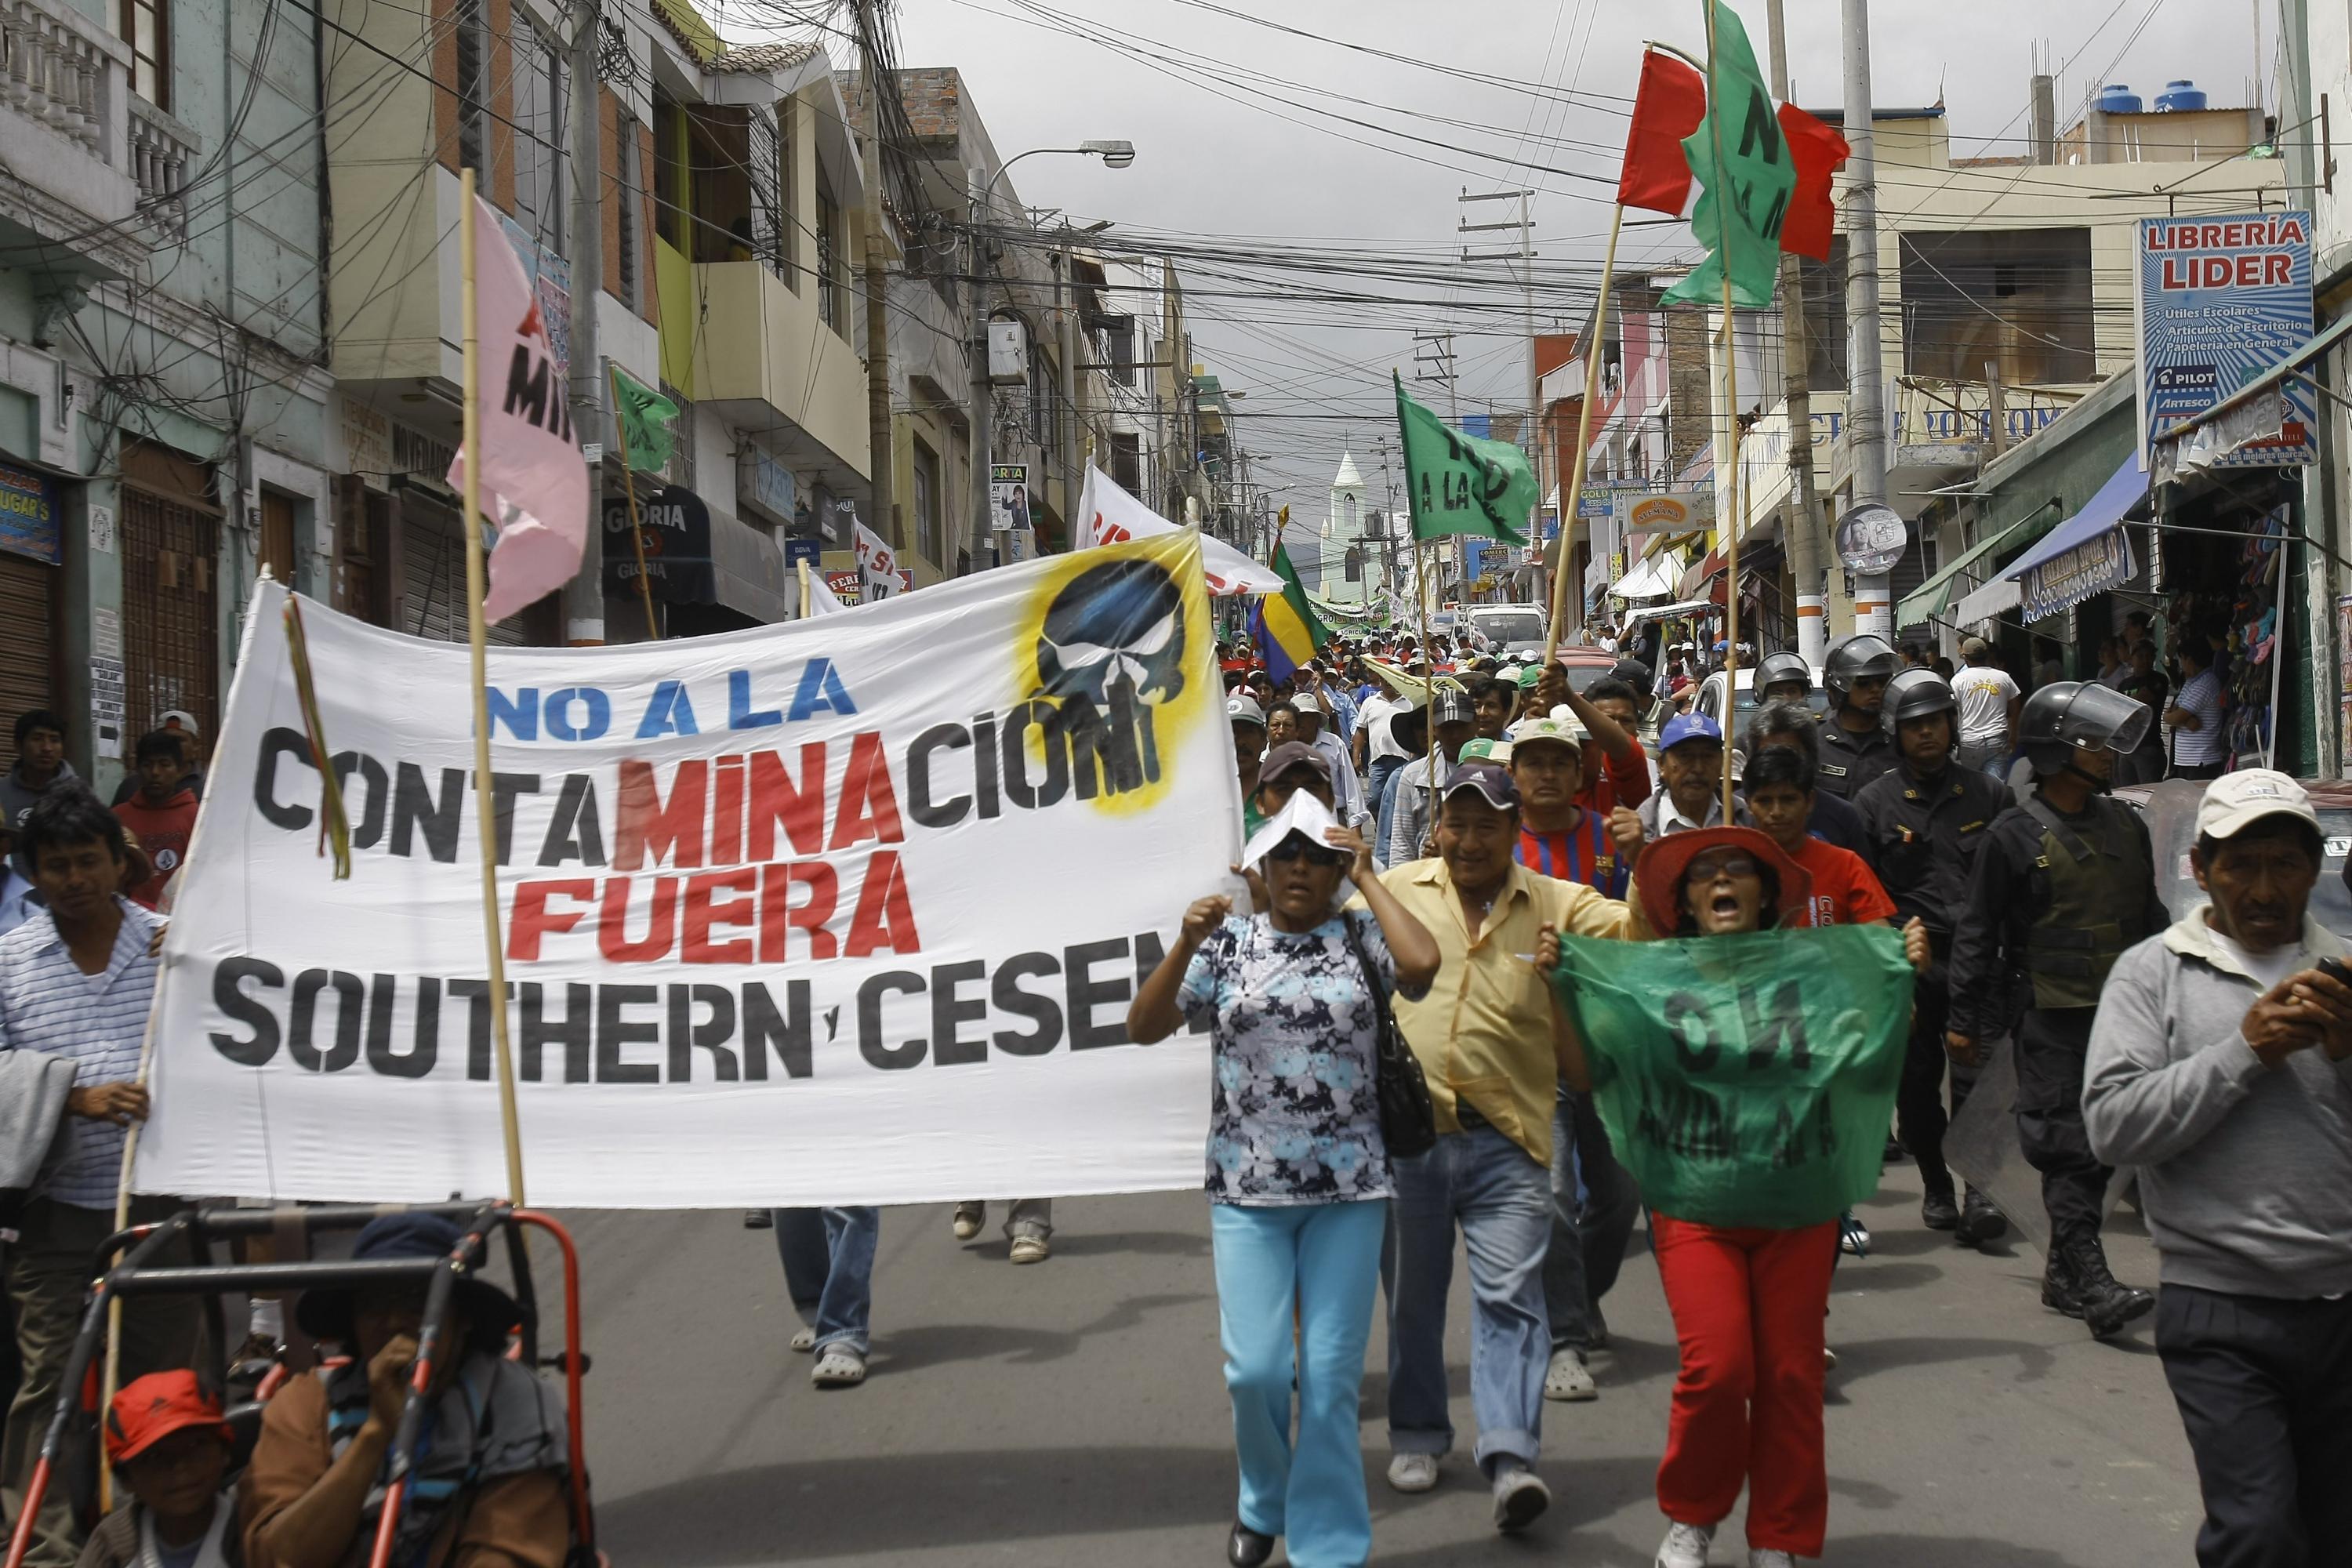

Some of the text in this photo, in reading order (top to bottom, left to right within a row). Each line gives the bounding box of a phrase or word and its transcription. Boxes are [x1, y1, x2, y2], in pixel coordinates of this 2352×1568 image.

[2147, 216, 2304, 251] LIBRERÍA
[2163, 254, 2293, 289] LIDER
[2203, 306, 2260, 318] Escolares
[2225, 323, 2242, 332] de
[2243, 321, 2303, 332] Escritorio
[2226, 341, 2241, 350] en
[2245, 336, 2294, 349] General
[2176, 372, 2215, 384] PILOT
[2242, 451, 2277, 463] mejores
[1581, 490, 1608, 499] GOLD
[1637, 506, 1680, 522] ALEMANA
[471, 657, 858, 742] NO A LA
[506, 849, 921, 964] FUERA
[209, 956, 812, 1083] SOUTHERN
